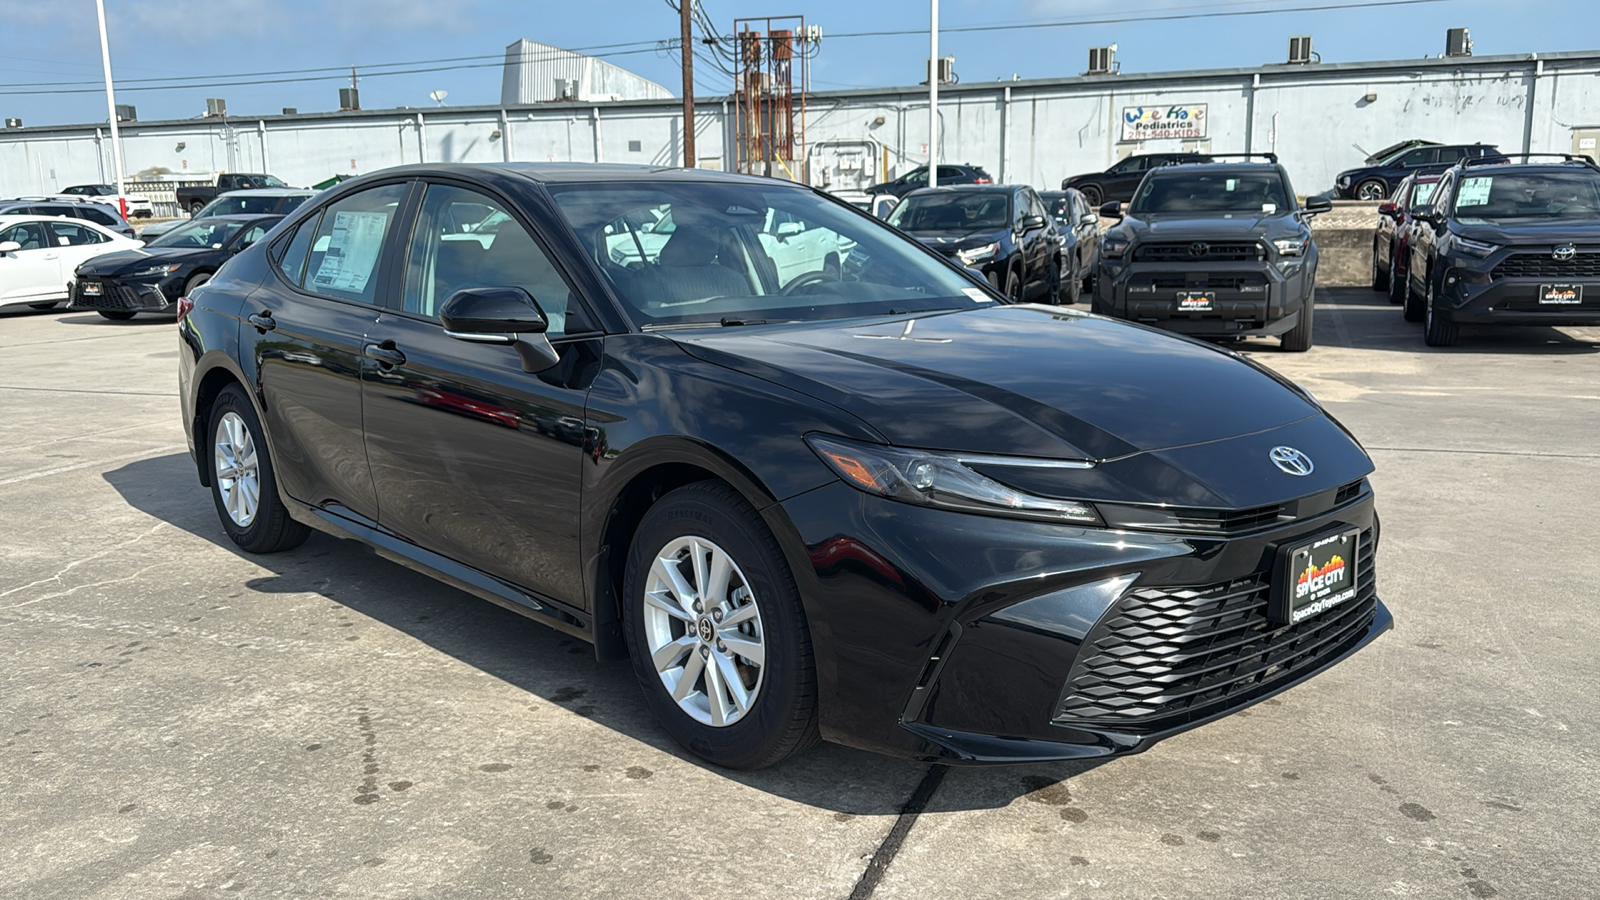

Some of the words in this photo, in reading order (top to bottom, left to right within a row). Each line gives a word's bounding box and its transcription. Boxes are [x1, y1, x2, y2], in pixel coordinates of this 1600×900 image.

[1126, 106, 1162, 123] Wee
[1166, 105, 1204, 120] Kare
[1128, 128, 1201, 139] 281-540-KIDS
[1135, 121, 1193, 130] Pediatrics
[1296, 573, 1325, 598] SPACE
[1325, 567, 1345, 585] CITY
[1293, 588, 1355, 621] SpaceCityToyota.com
